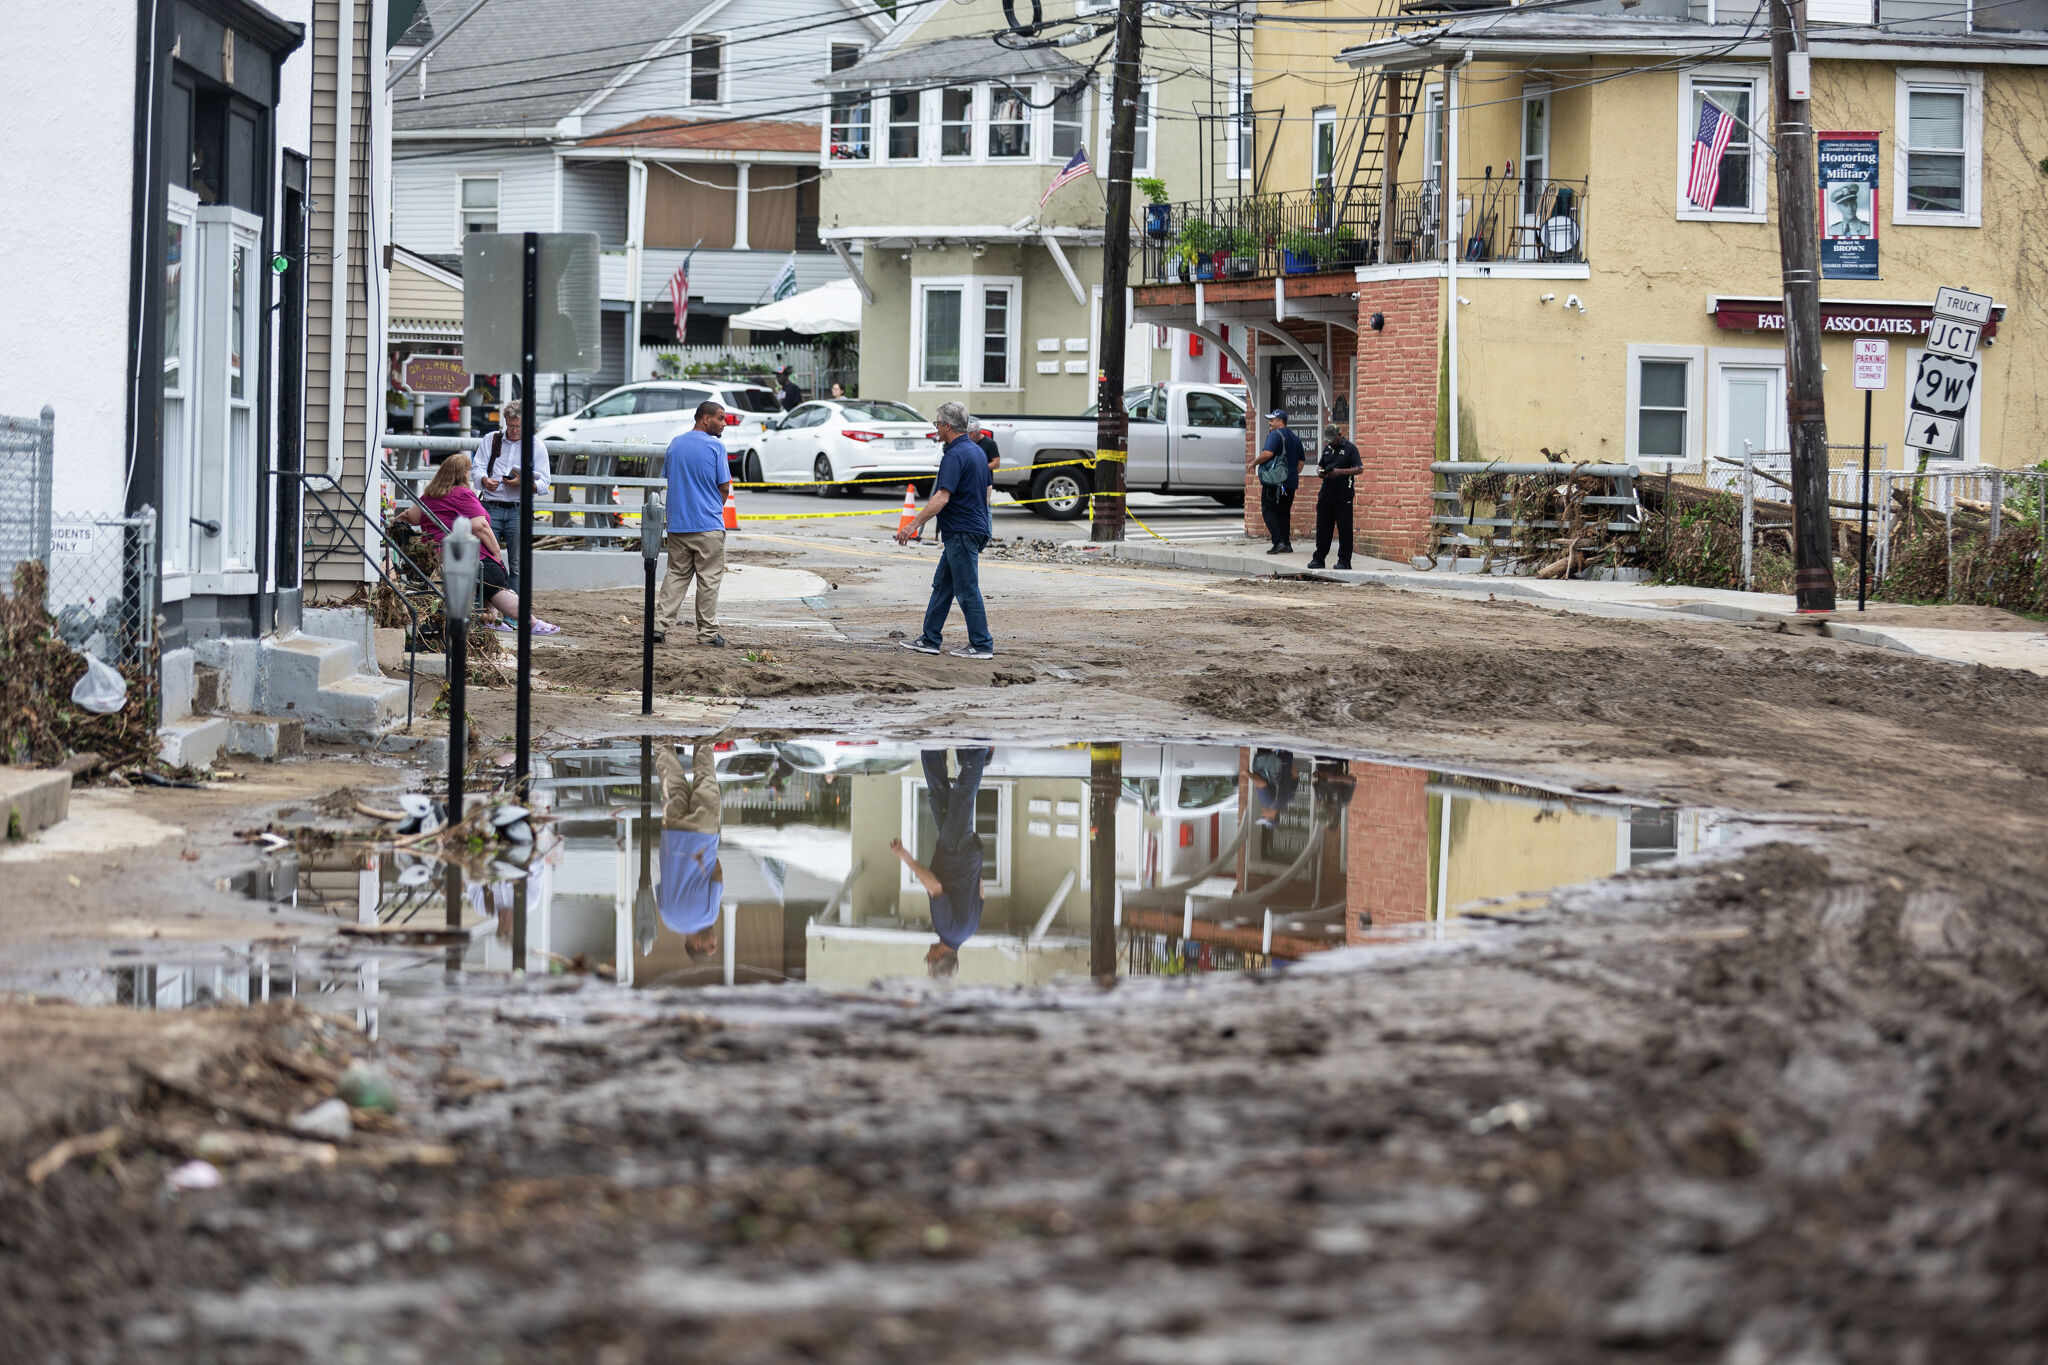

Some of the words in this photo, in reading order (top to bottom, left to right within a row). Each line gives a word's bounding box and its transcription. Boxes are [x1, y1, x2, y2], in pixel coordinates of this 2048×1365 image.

[1821, 153, 1876, 164] Honoring
[1826, 169, 1870, 180] Military
[1946, 297, 1981, 313] TRUCK
[1824, 316, 1917, 335] ASSOCIATES,
[1931, 324, 1977, 352] JCT
[1865, 343, 1877, 352] NO
[1856, 354, 1885, 364] PARKING
[422, 373, 456, 384] Family
[1926, 369, 1964, 403] 9W
